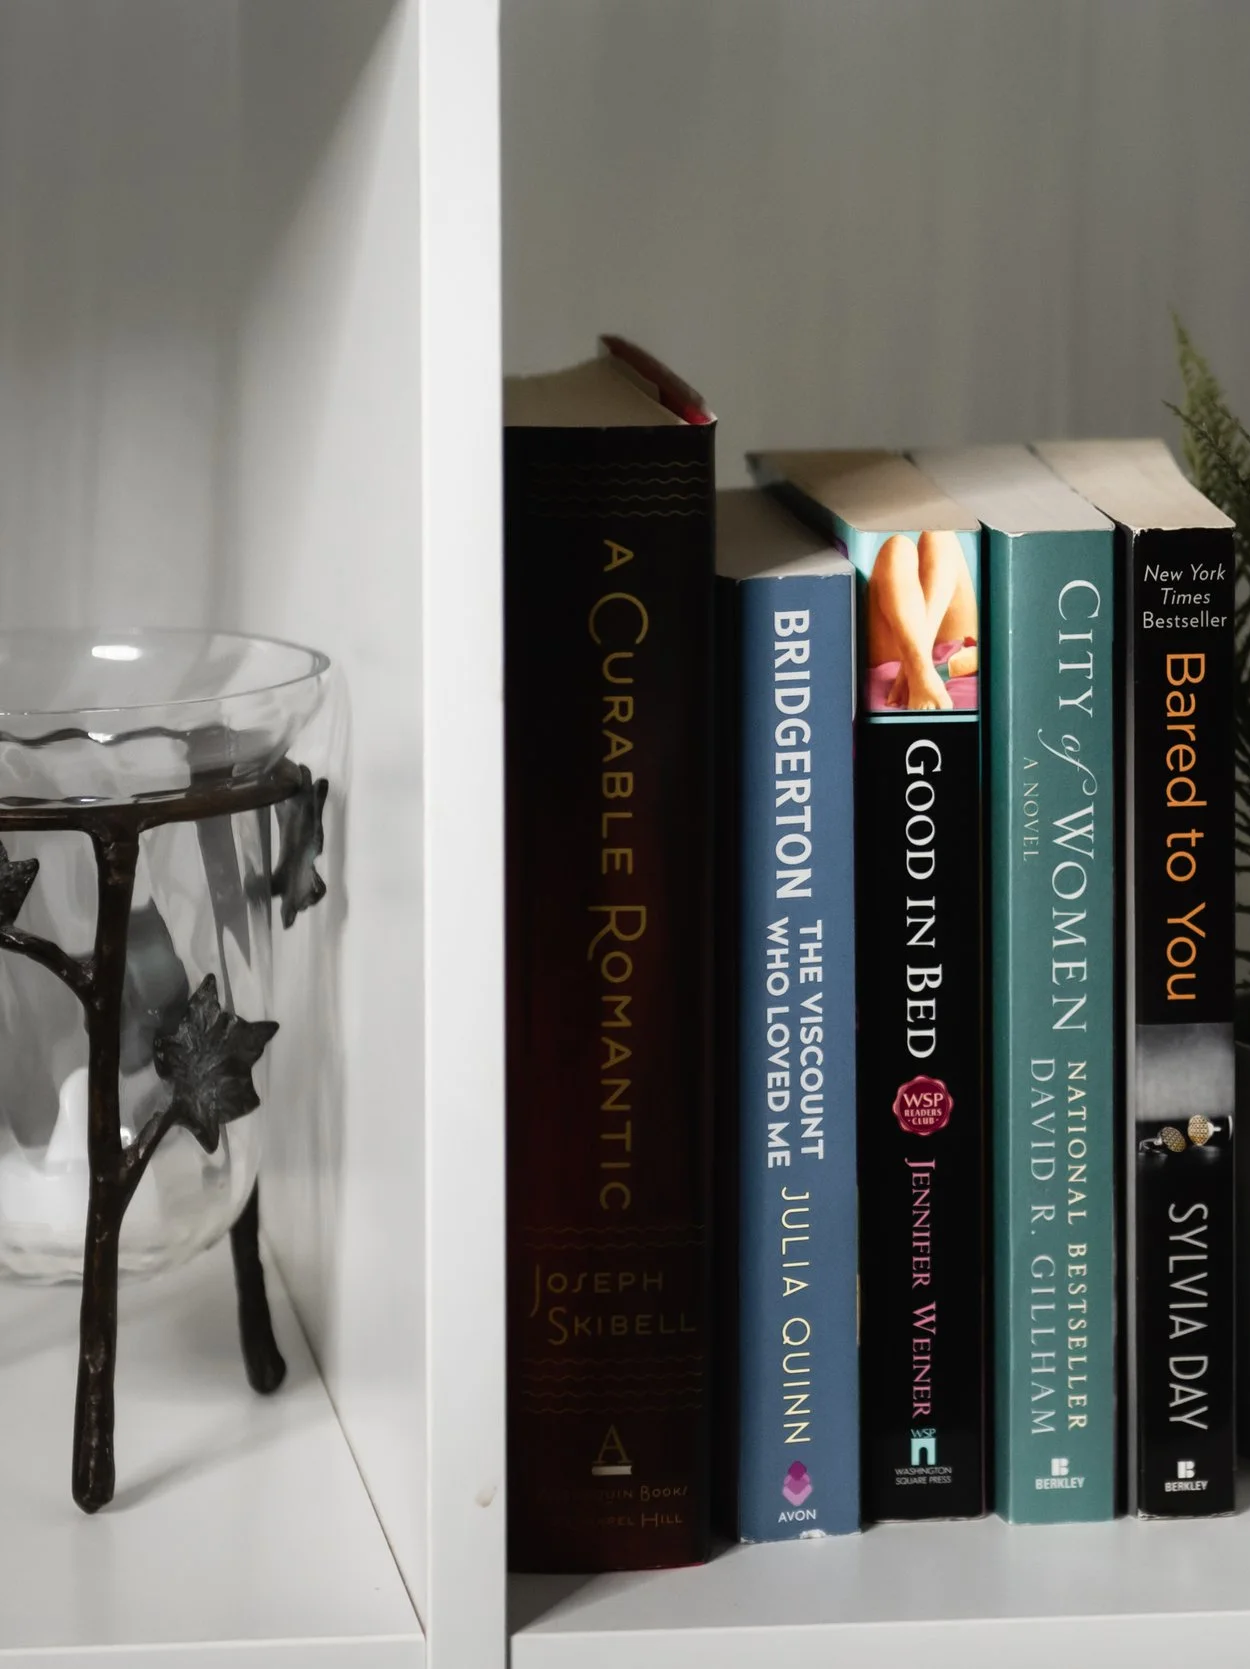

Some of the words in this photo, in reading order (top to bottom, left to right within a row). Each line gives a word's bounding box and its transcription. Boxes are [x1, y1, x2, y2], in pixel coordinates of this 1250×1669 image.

[603, 539, 635, 572] A
[1143, 564, 1183, 582] New
[1190, 562, 1226, 581] York
[1143, 610, 1228, 629] Bestseller
[1160, 587, 1211, 605] Times
[1058, 579, 1101, 718] CITY
[589, 592, 649, 876] CURABLE
[774, 609, 813, 899] BRIDGERTON
[1023, 756, 1039, 770] A
[1035, 728, 1098, 797] of
[1165, 653, 1208, 808] Bared
[905, 739, 942, 880] GOOD
[1023, 782, 1039, 864] NOVEL
[1166, 828, 1205, 882] to
[799, 919, 823, 984] THE
[906, 895, 936, 948] IN
[1051, 802, 1095, 1032] WOMEN
[1166, 902, 1206, 1001] You
[766, 916, 790, 997] WHO
[906, 963, 943, 1059] BED
[588, 904, 648, 1209] ROMANTIC
[766, 1005, 791, 1112] LOVED
[799, 991, 825, 1160] VISCOUNT
[903, 1092, 944, 1108] WSP
[904, 1108, 942, 1117] READERS
[911, 1116, 936, 1126] CLUB
[1030, 1058, 1056, 1181] DAVID
[767, 1121, 791, 1169] ME
[1067, 1061, 1087, 1225] NATIONAL
[781, 1186, 810, 1297] JULIA
[904, 1157, 936, 1288] JENNIFER
[1030, 1204, 1056, 1235] R.
[530, 1263, 664, 1319] JOSEPH
[1168, 1203, 1209, 1340] SYLVIA
[547, 1304, 697, 1347] SKIBELL
[912, 1301, 937, 1418] WEINER
[1030, 1254, 1056, 1435] GILLHAM
[1067, 1243, 1088, 1430] BESTSELLER
[782, 1317, 811, 1444] QUINN
[1169, 1355, 1209, 1430] DAY
[910, 1428, 937, 1439] WSP
[895, 1467, 952, 1476] WASHINGTON
[895, 1476, 928, 1486] SQUARE
[928, 1475, 952, 1484] PRESS
[1035, 1476, 1085, 1490] BERKLEY
[1164, 1480, 1208, 1493] BERKLEY
[641, 1512, 683, 1529] HILL
[778, 1507, 817, 1523] AVON
